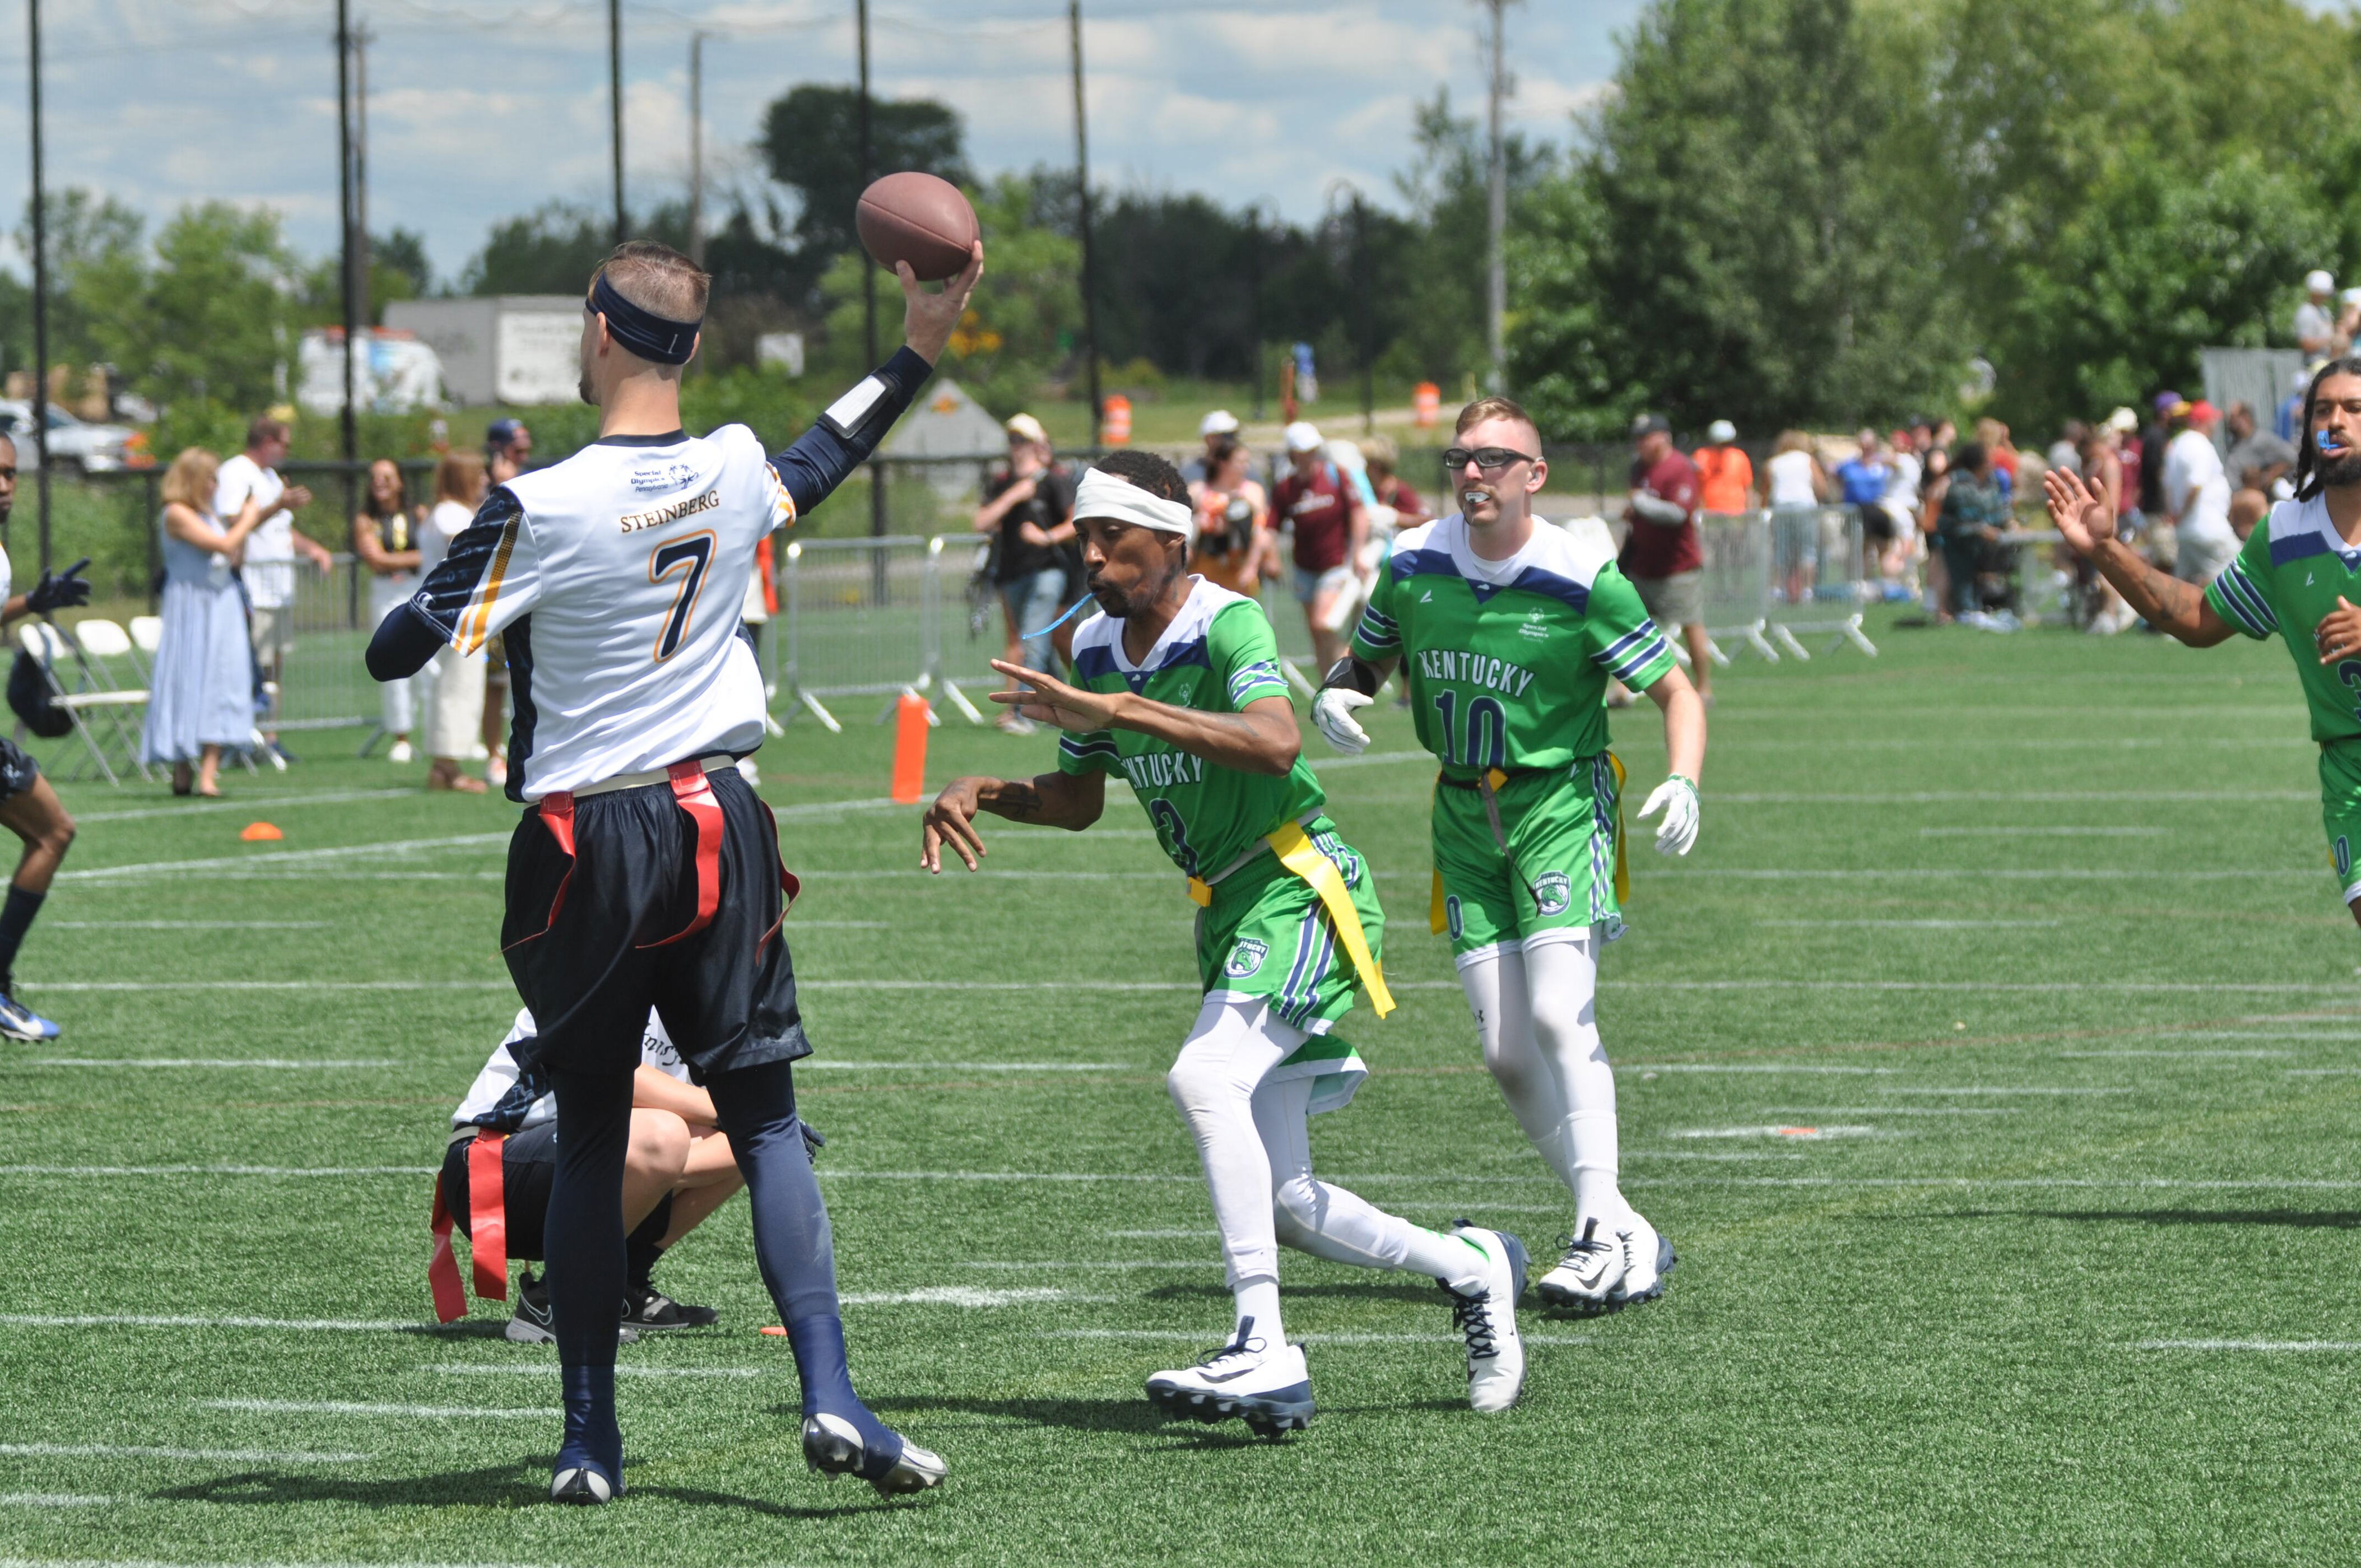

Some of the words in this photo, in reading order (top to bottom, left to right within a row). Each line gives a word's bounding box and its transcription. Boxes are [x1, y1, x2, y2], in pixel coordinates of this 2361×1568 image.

[620, 490, 719, 533] STEINBERG
[649, 529, 717, 663] 7
[1417, 649, 1535, 698] KENTUCKY
[1434, 689, 1506, 767] 10
[1535, 875, 1568, 890] KENTUCKY
